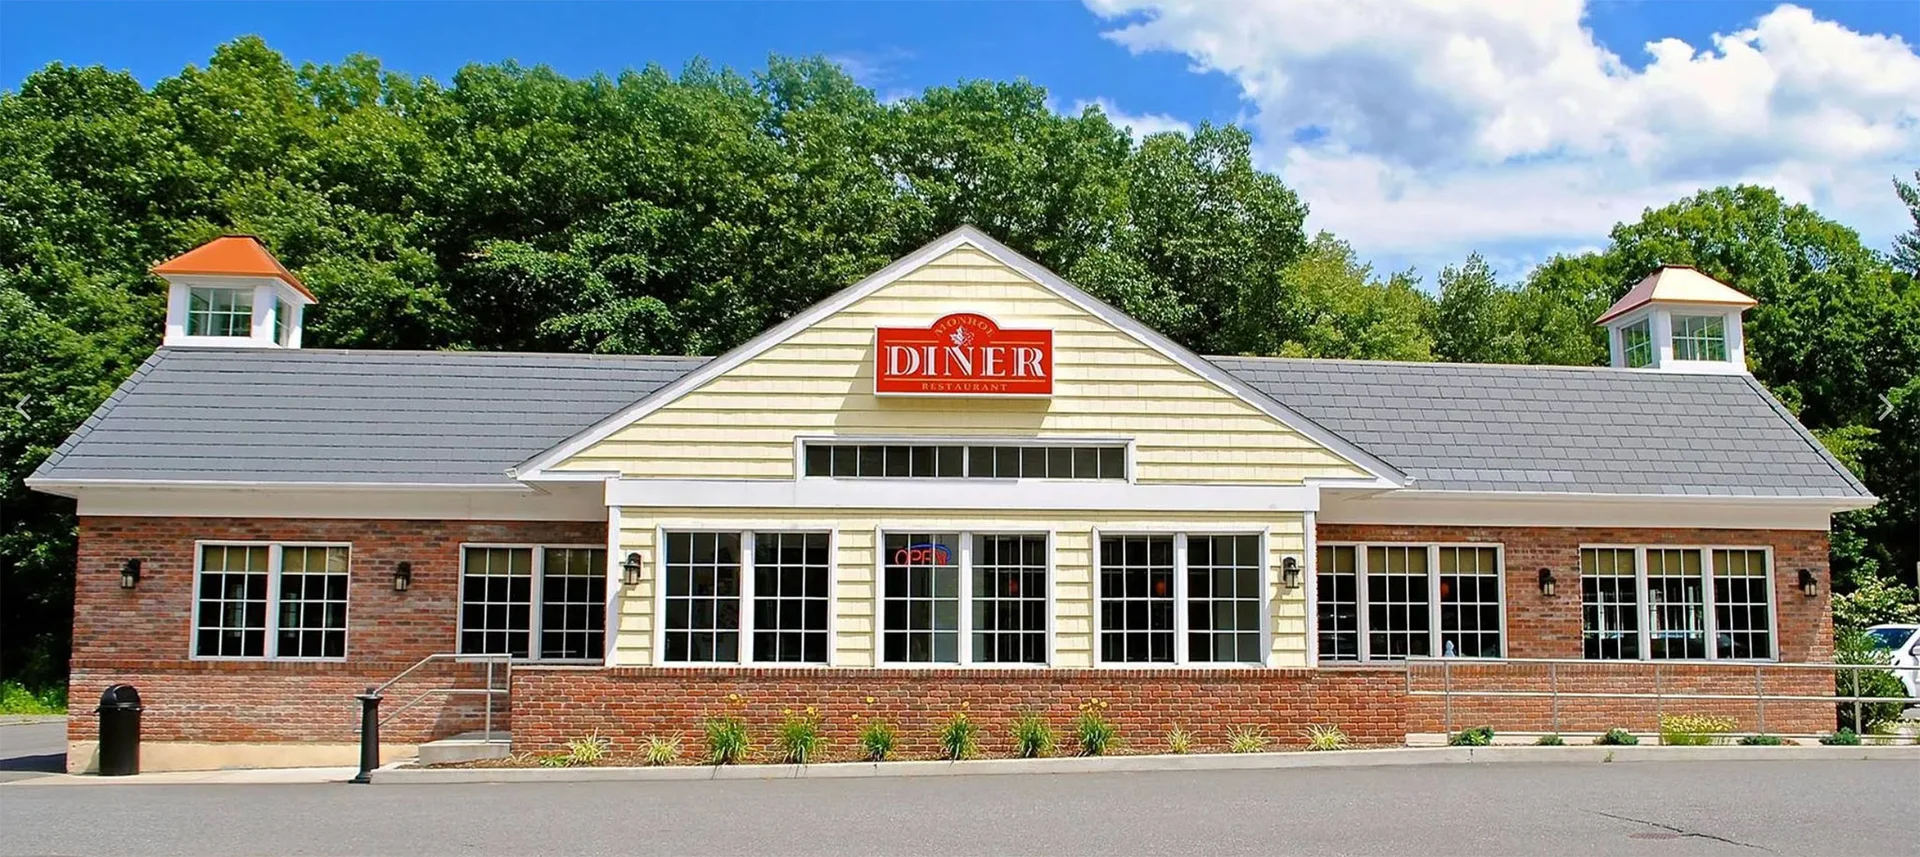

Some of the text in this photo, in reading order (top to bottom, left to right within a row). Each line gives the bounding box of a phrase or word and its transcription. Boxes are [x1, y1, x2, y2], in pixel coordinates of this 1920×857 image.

[935, 317, 996, 338] MONROE
[884, 345, 1047, 377] DINER
[921, 382, 1008, 391] RESTAURANT
[895, 549, 947, 566] OPEN
